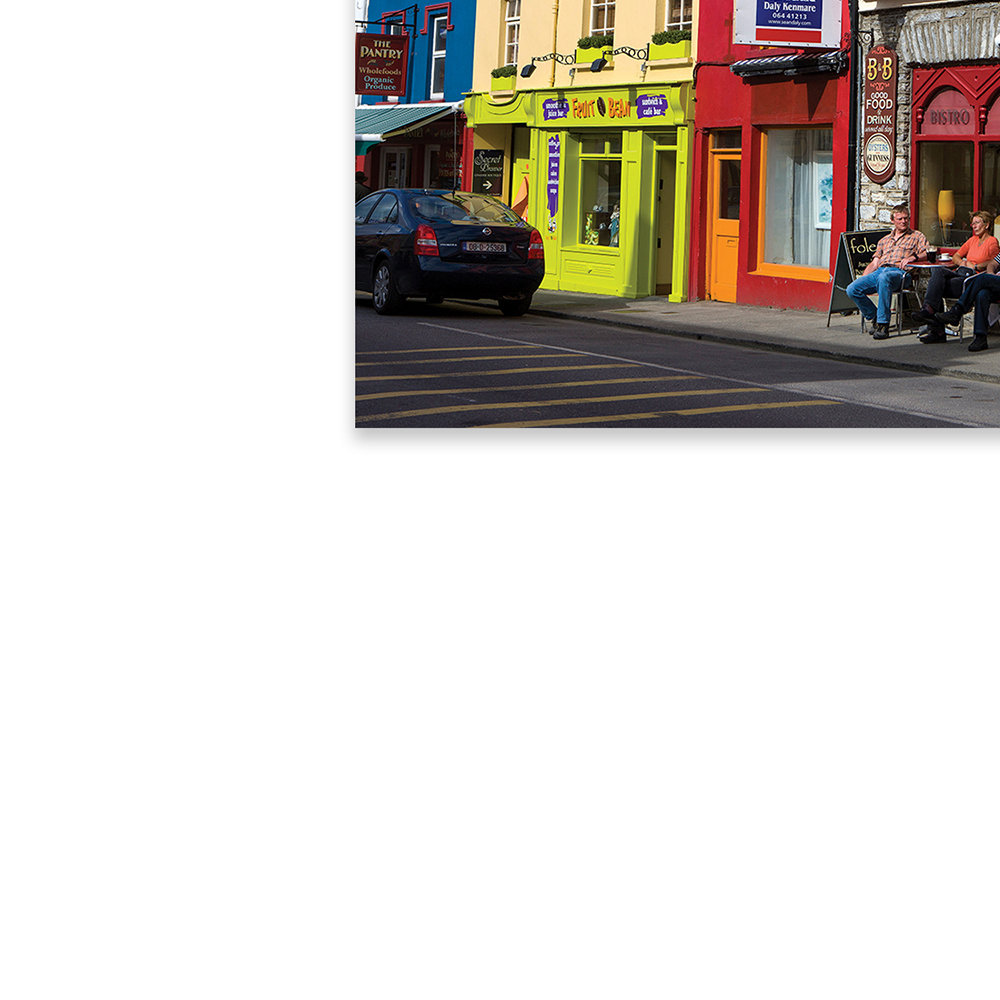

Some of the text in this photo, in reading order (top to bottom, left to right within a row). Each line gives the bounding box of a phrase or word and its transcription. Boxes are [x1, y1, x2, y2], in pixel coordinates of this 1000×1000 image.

[763, 1, 816, 12] Daly Kenmare
[373, 40, 391, 48] THE
[360, 45, 403, 59] PANTRY
[359, 66, 402, 75] Wholefoods
[363, 75, 395, 84] Organic
[365, 82, 397, 91] Produce
[870, 91, 889, 100] GOOD
[866, 98, 893, 110] FOOD
[867, 115, 892, 125] DRINK
[930, 108, 971, 126] BISTRO
